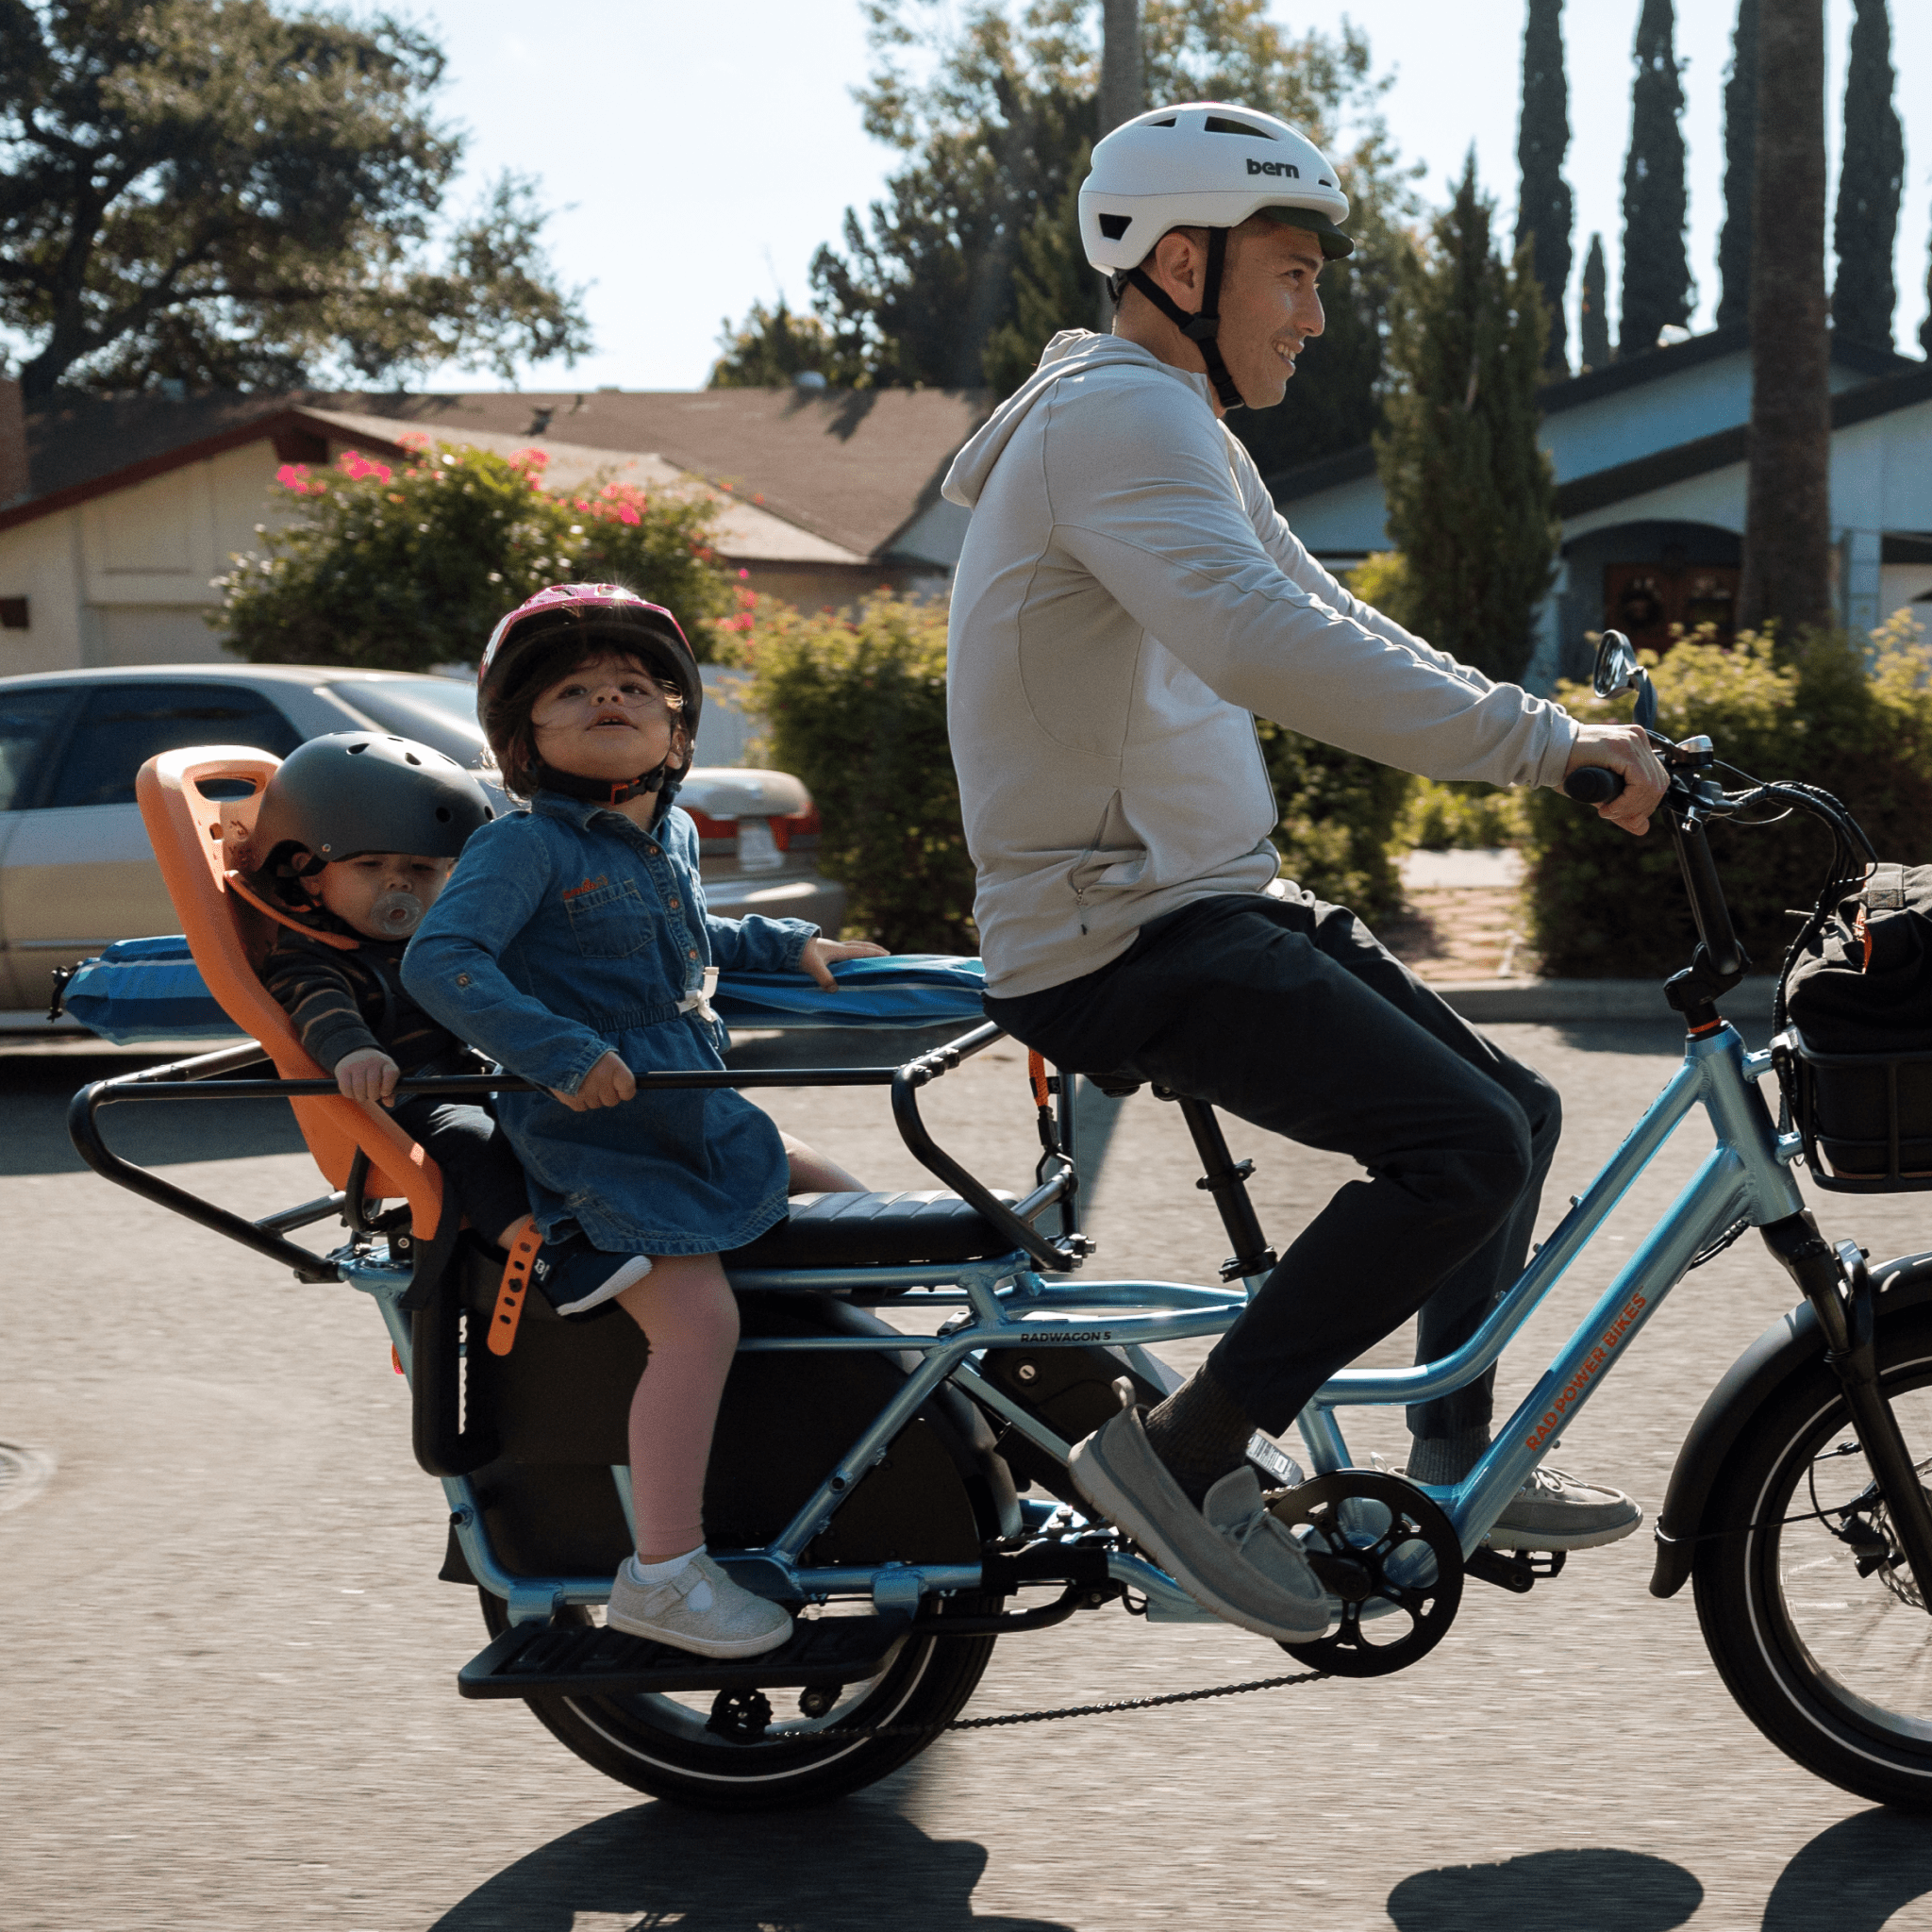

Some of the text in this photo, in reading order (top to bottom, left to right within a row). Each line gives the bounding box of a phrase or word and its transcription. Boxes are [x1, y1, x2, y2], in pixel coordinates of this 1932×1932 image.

[1246, 158, 1300, 179] bern
[1021, 1331, 1112, 1342] RADWAGON 5
[1525, 1291, 1647, 1452] RAD POWER BIKES
